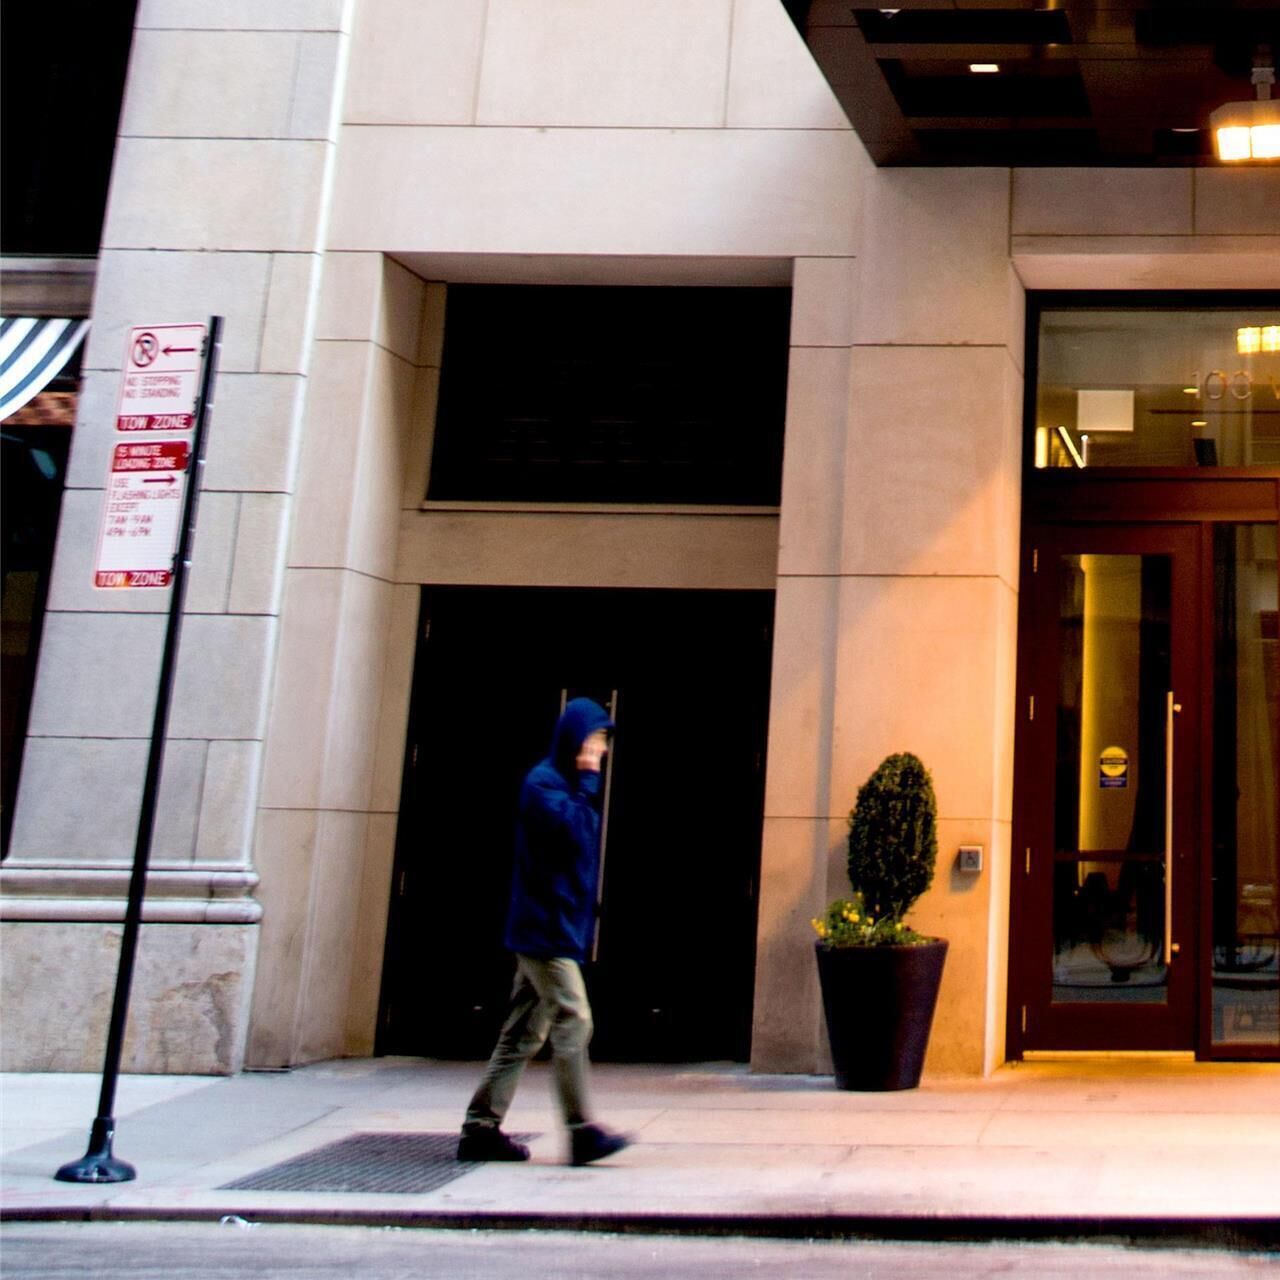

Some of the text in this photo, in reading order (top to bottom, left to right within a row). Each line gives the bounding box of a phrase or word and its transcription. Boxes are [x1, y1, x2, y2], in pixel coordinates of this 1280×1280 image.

[1190, 369, 1253, 400] 100
[121, 414, 188, 429] TOW ZONE
[152, 456, 177, 469] ZONE
[99, 571, 166, 586] TOW ZONE
